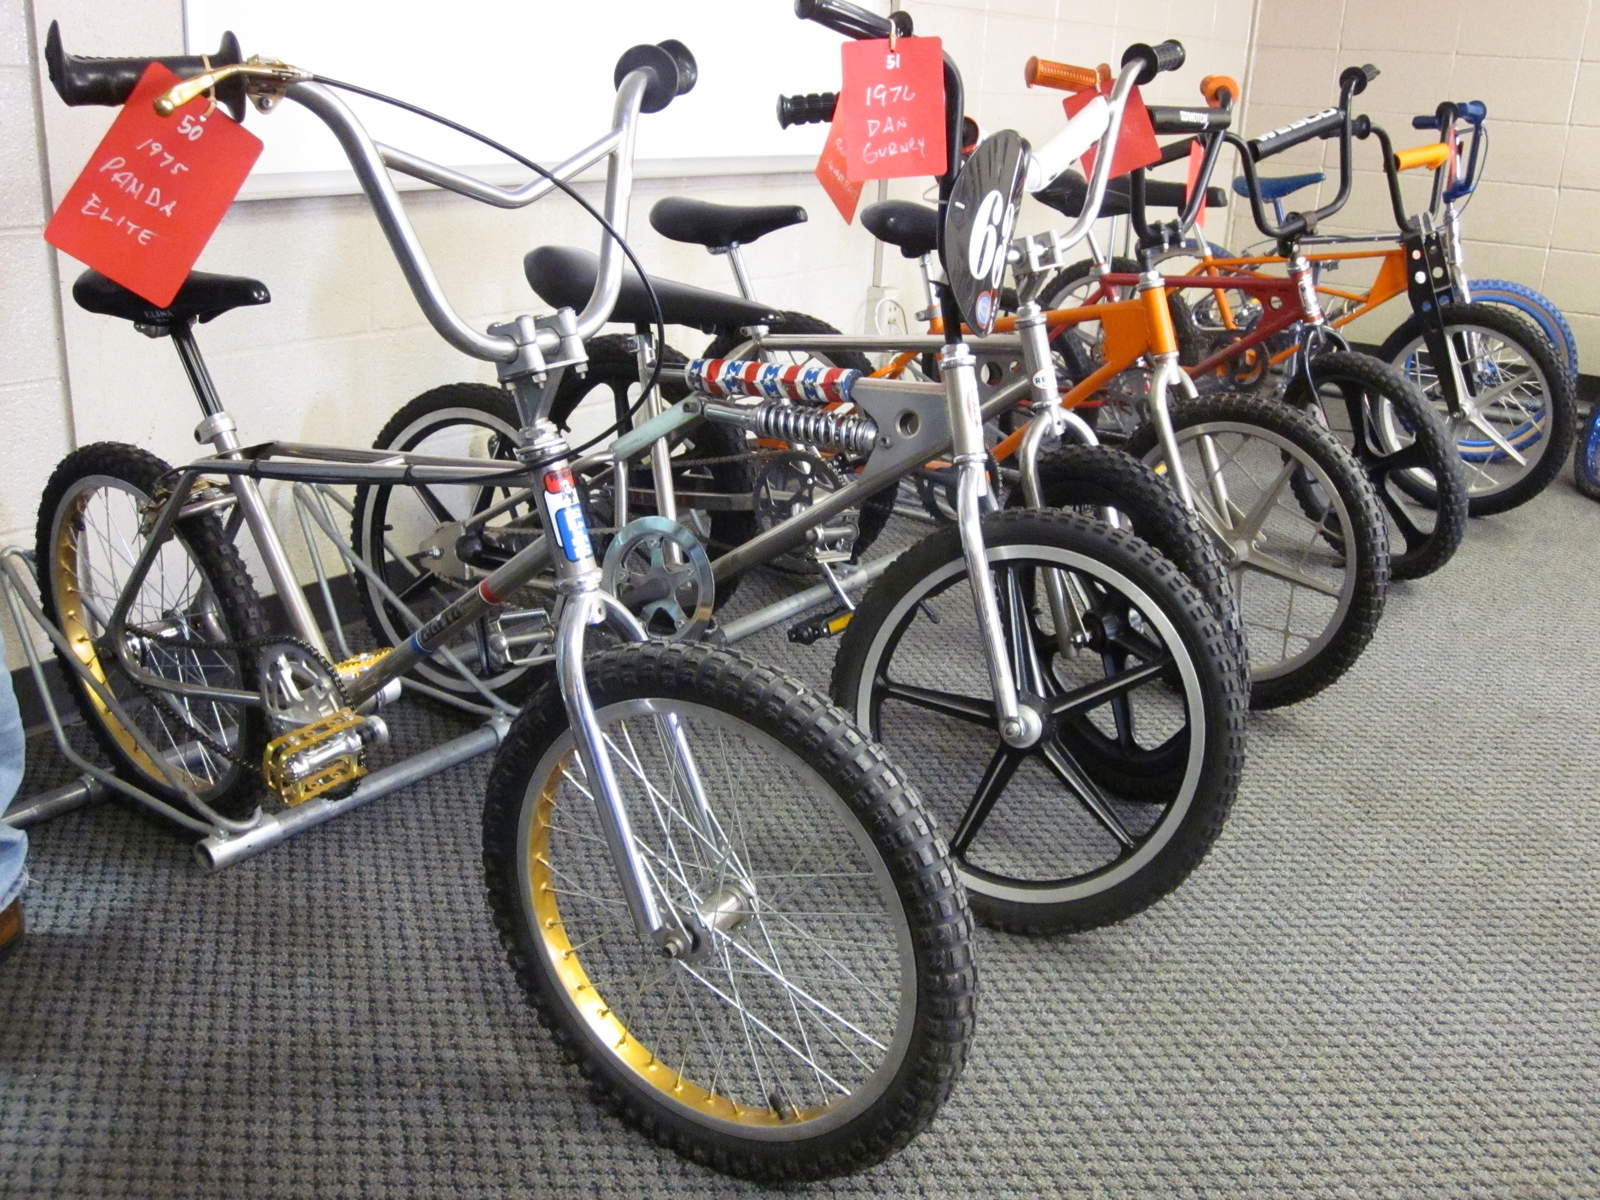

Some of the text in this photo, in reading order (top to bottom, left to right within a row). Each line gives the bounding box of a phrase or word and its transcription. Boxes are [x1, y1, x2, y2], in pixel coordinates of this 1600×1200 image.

[885, 53, 901, 70] 51
[176, 114, 205, 141] 50
[866, 116, 908, 137] DAN
[136, 138, 189, 175] 1975
[99, 157, 177, 217] PANDA
[80, 193, 160, 245] ELITE
